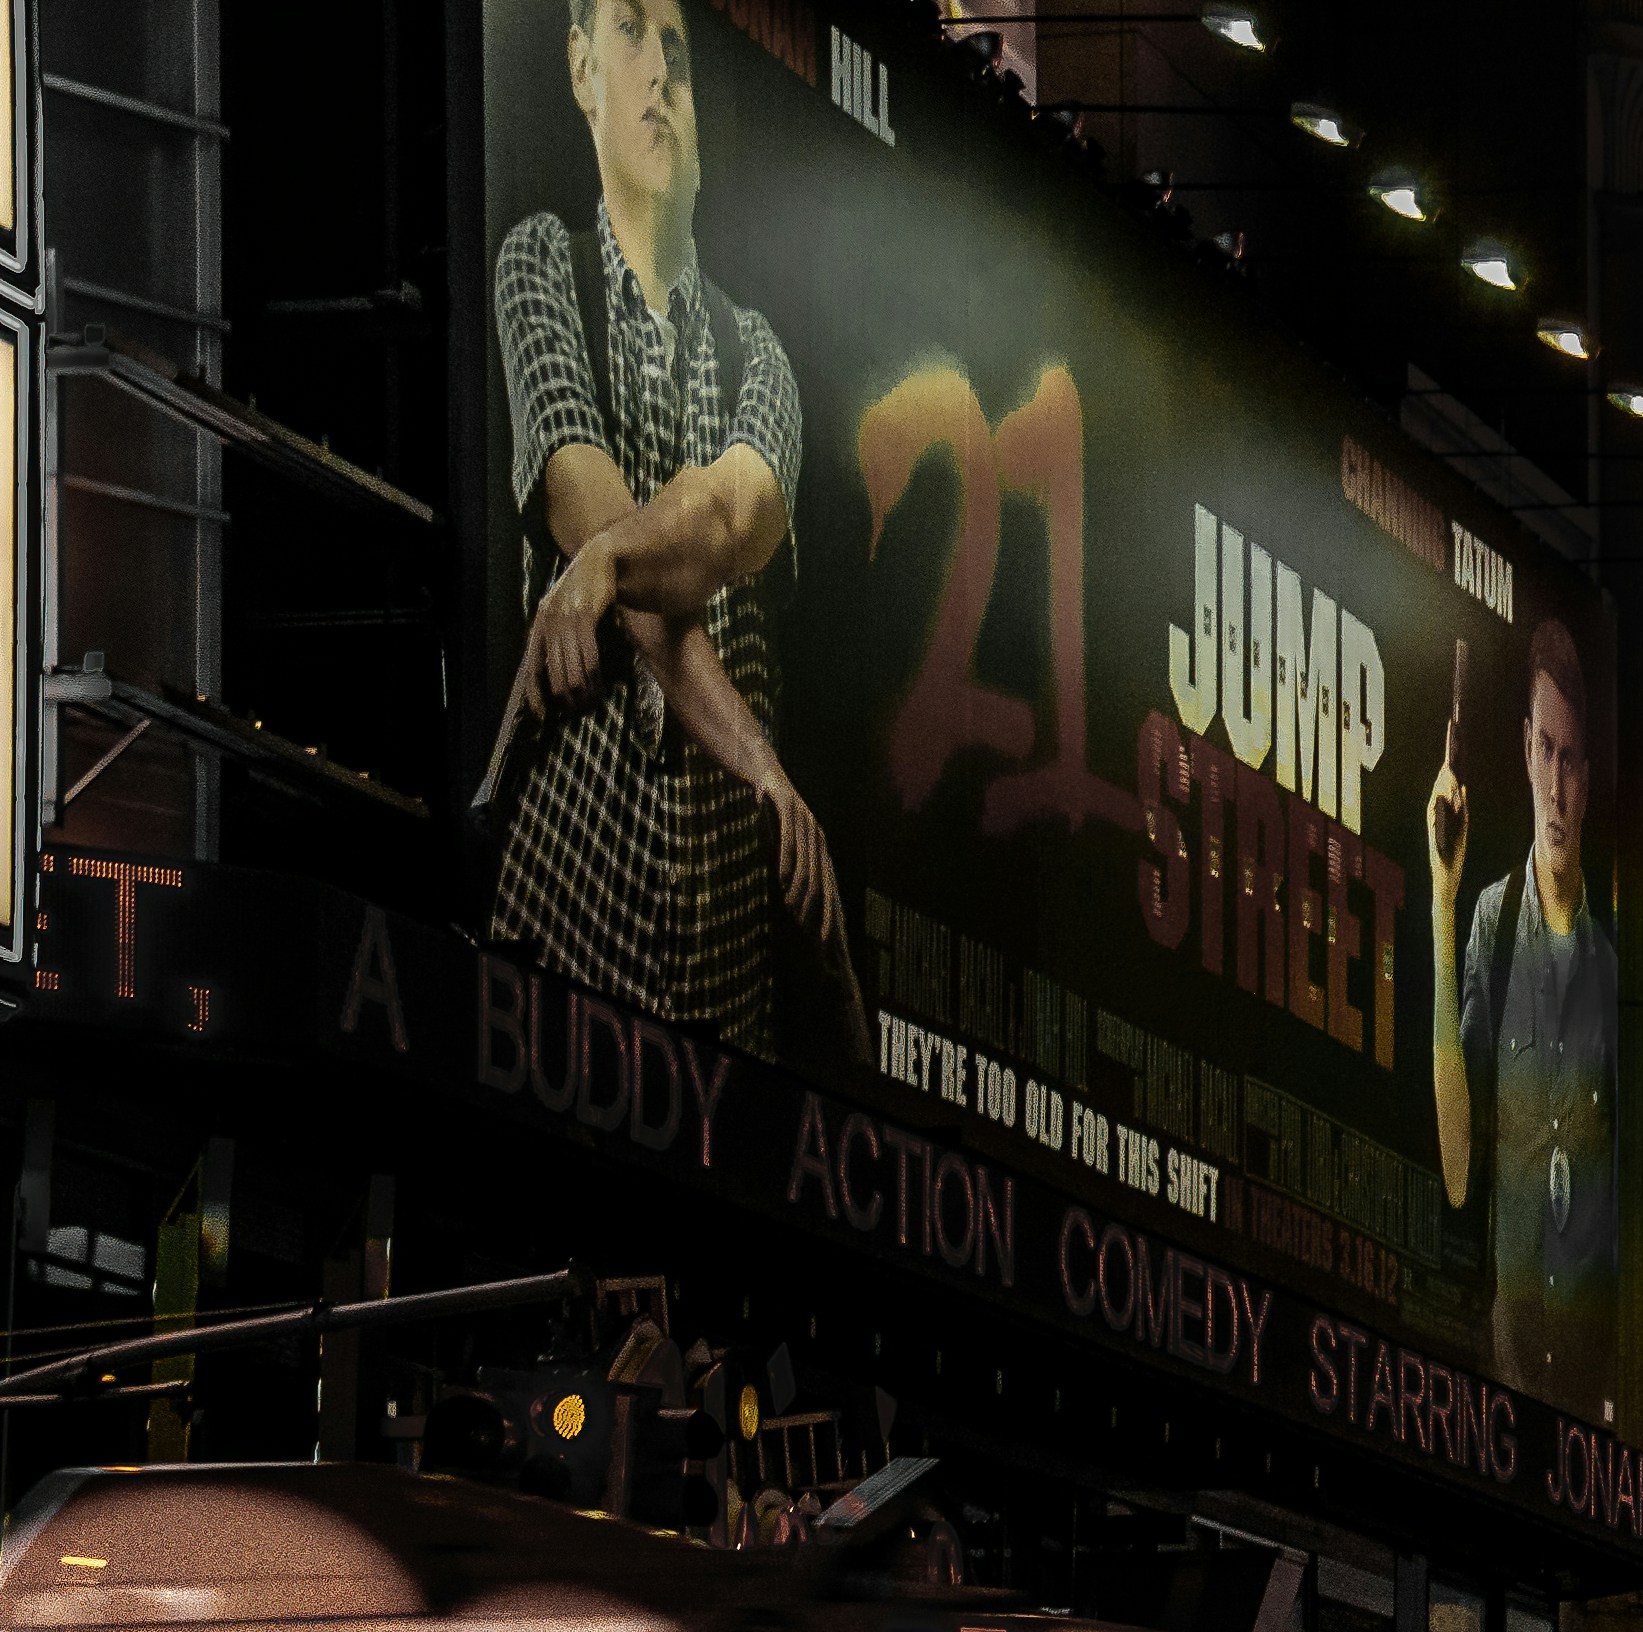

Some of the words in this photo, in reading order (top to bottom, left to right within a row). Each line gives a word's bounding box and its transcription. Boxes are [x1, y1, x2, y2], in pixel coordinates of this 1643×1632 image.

[831, 24, 896, 148] HILL
[856, 348, 1141, 833] 21
[1168, 501, 1386, 836] JUMP
[1451, 520, 1514, 626] TATUM
[1137, 708, 1405, 1071] STREET
[477, 951, 731, 1169] BUDDY
[788, 1090, 1016, 1288] ACTION
[1057, 1205, 1273, 1385] COMEDY
[1309, 1313, 1517, 1483] STARRING
[877, 1008, 968, 1109] THEY'RE
[976, 1052, 1018, 1130] TOO
[1026, 1079, 1064, 1152] OLD
[1071, 1100, 1110, 1176] FOR
[1116, 1122, 1161, 1197] THIS
[1167, 1147, 1221, 1225] SHIFT
